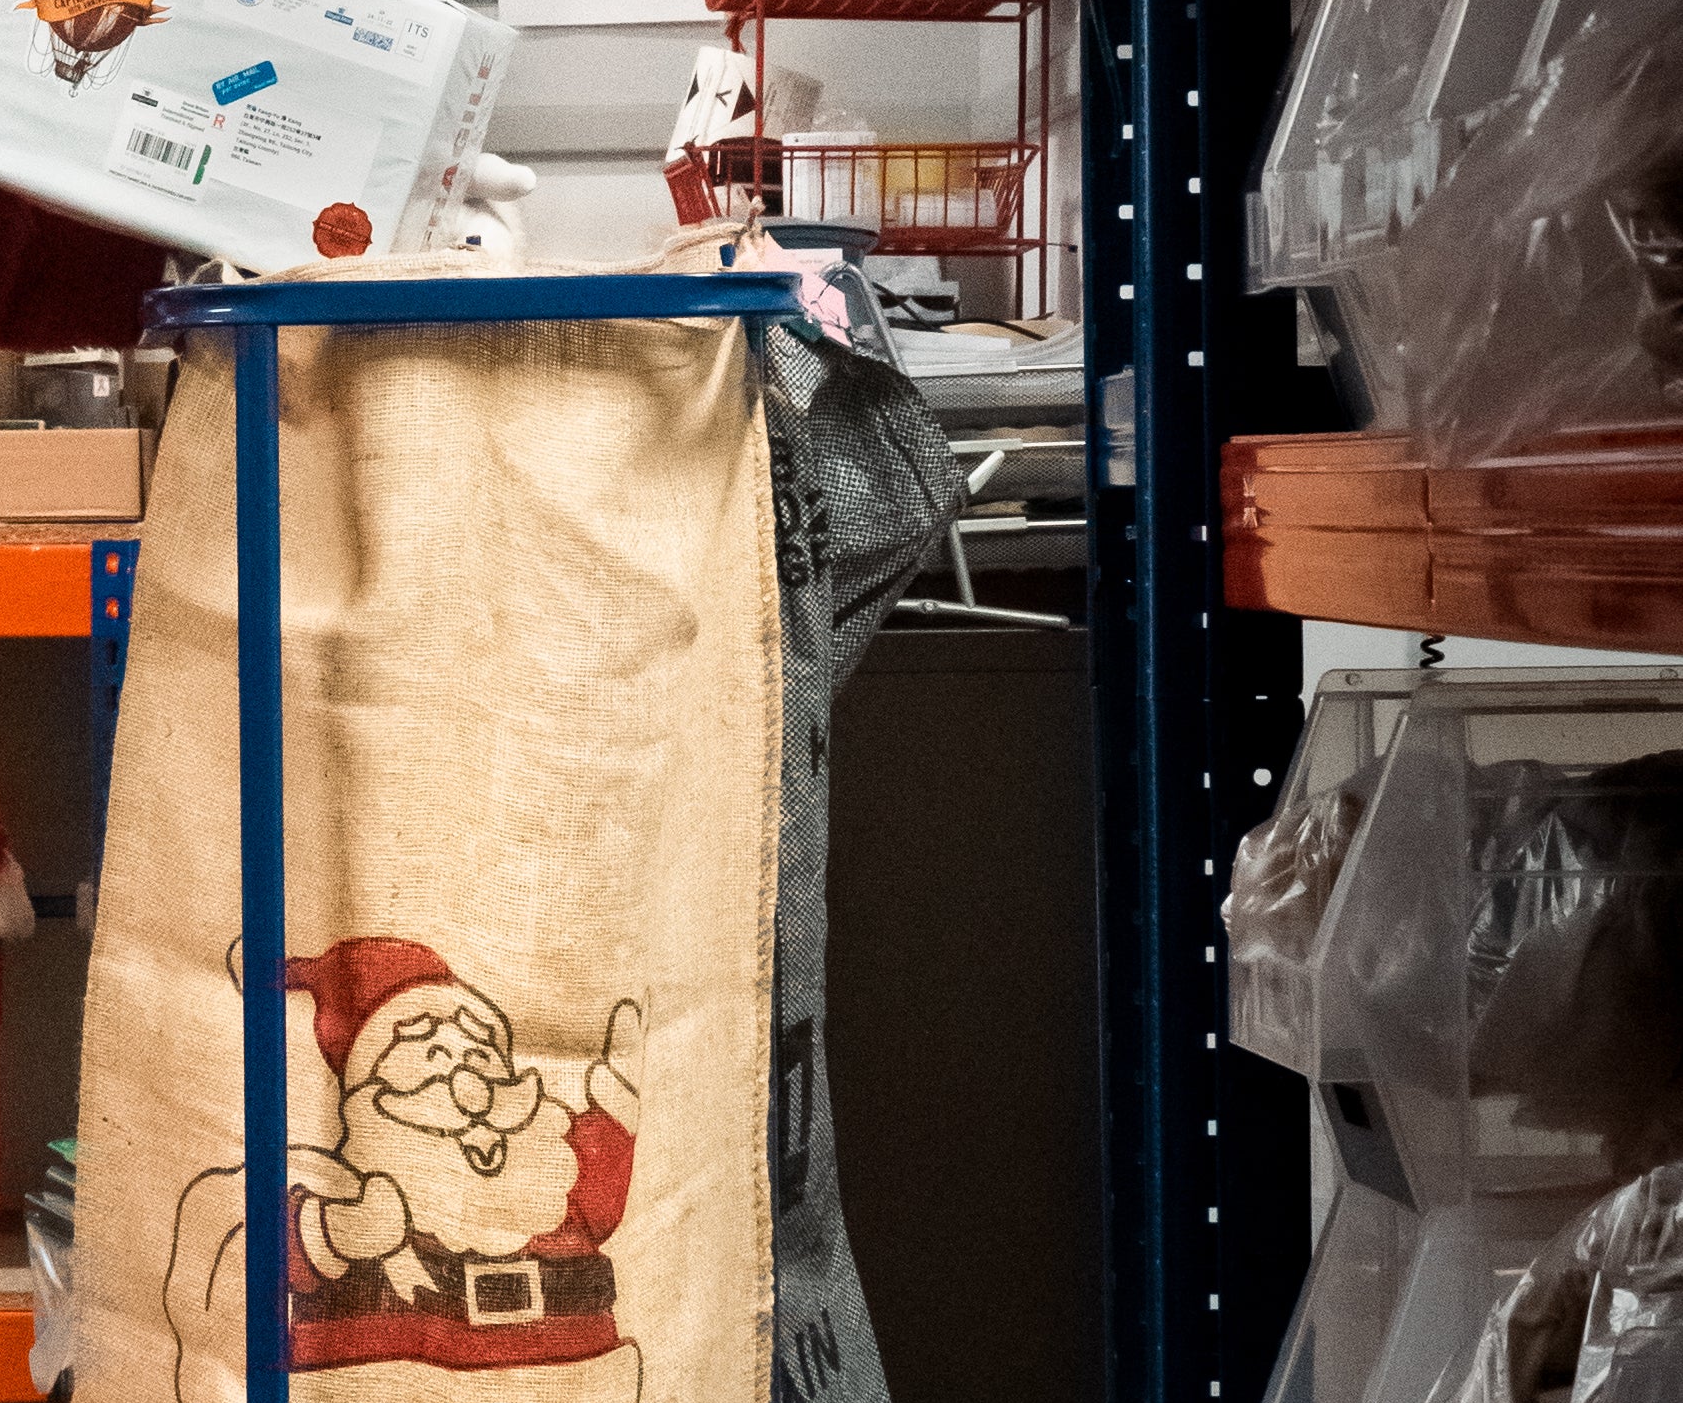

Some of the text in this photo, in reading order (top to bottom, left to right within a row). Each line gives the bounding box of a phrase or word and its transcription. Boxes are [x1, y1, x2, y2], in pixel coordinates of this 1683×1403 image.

[407, 22, 430, 39] ITS
[228, 75, 240, 85] AIR
[243, 65, 262, 77] MAIL
[213, 113, 226, 129] R
